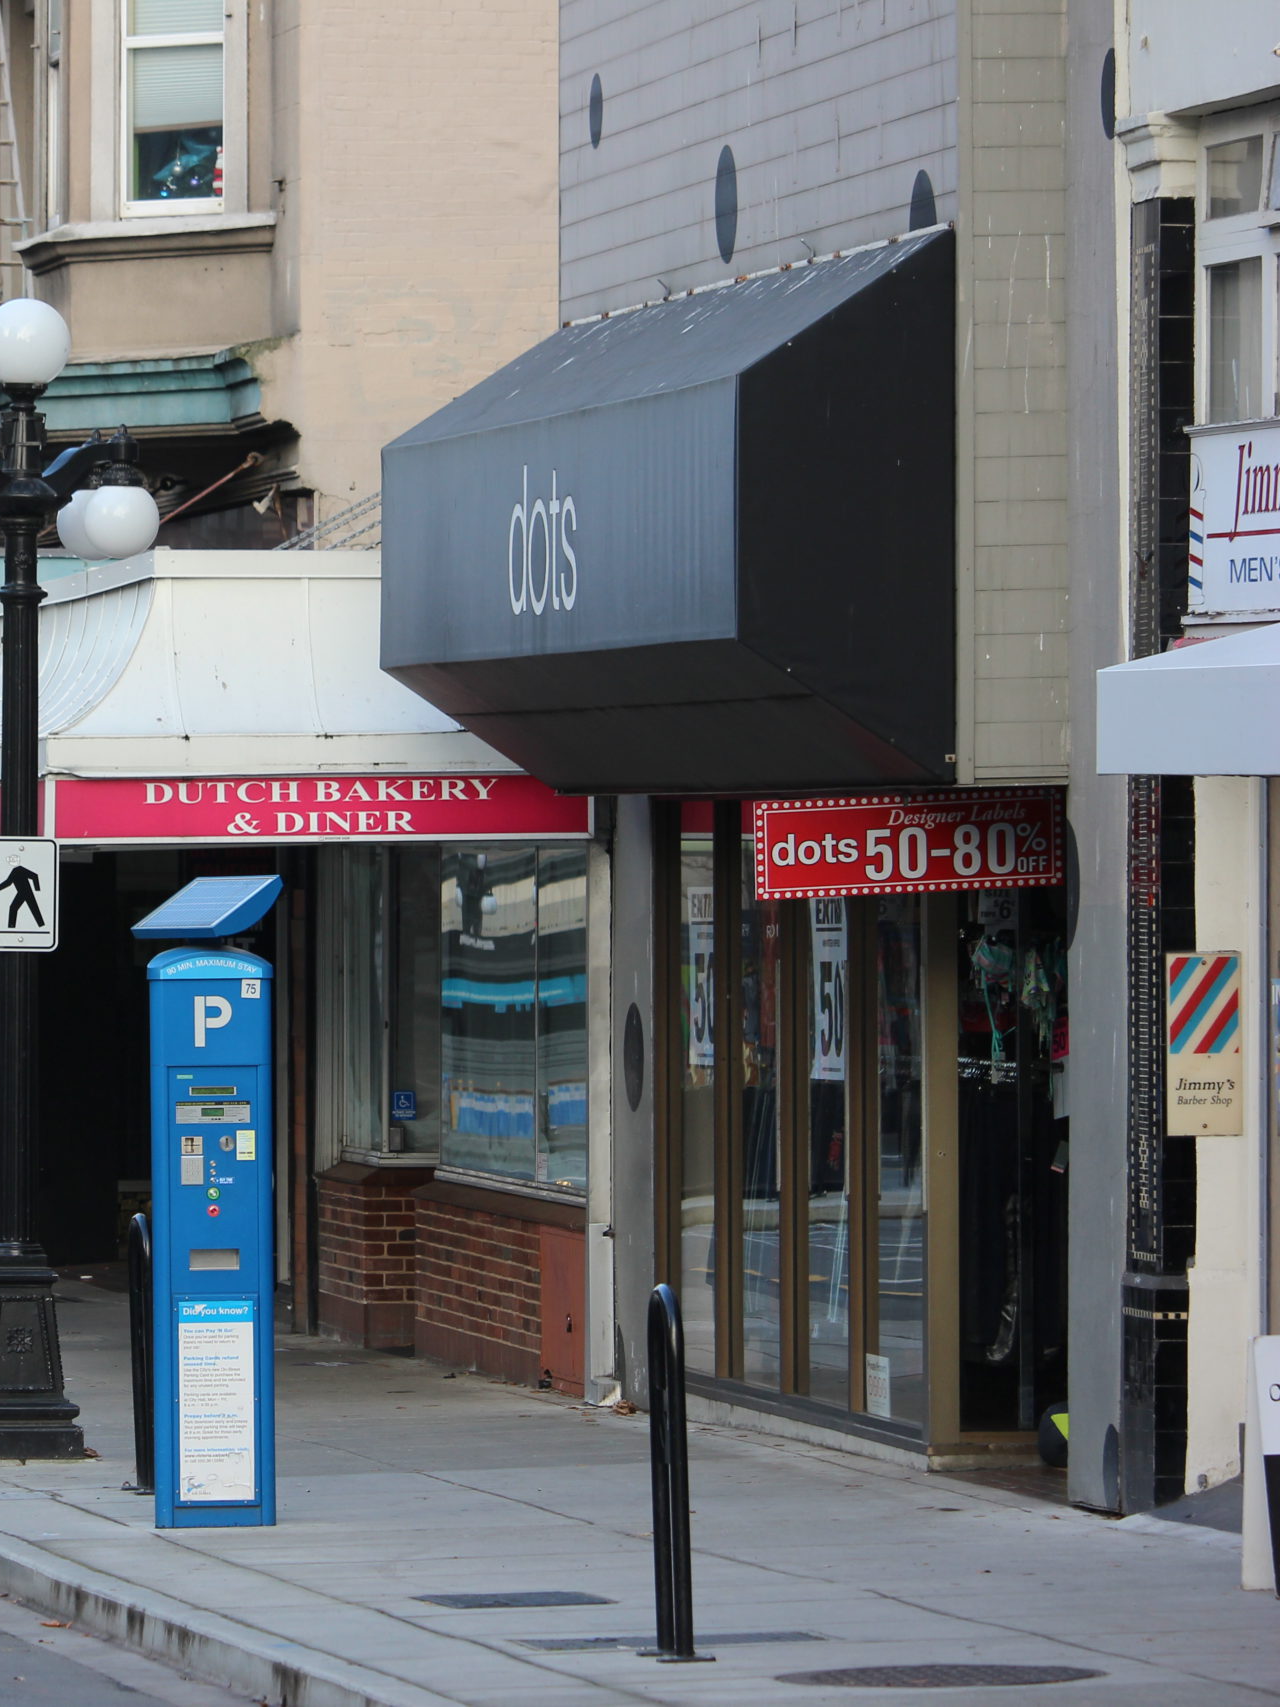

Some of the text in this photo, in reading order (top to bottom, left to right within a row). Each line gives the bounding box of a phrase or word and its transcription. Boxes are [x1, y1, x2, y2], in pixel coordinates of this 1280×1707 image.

[509, 464, 577, 616] dots
[1229, 556, 1280, 583] MEN'
[143, 778, 500, 804] DUTCH BAKERY
[226, 810, 416, 835] & DINER
[887, 801, 1026, 829] Designer Labels
[771, 833, 859, 866] dots
[1017, 856, 1049, 873] OFF
[166, 959, 257, 976] 90 MIN. MAXIMUM STAY
[245, 983, 257, 995] 75
[193, 995, 233, 1048] P
[1175, 1078, 1235, 1094] Jimmy's
[1177, 1095, 1233, 1107] Barber Shop
[200, 1308, 217, 1317] you
[220, 1306, 249, 1315] know?
